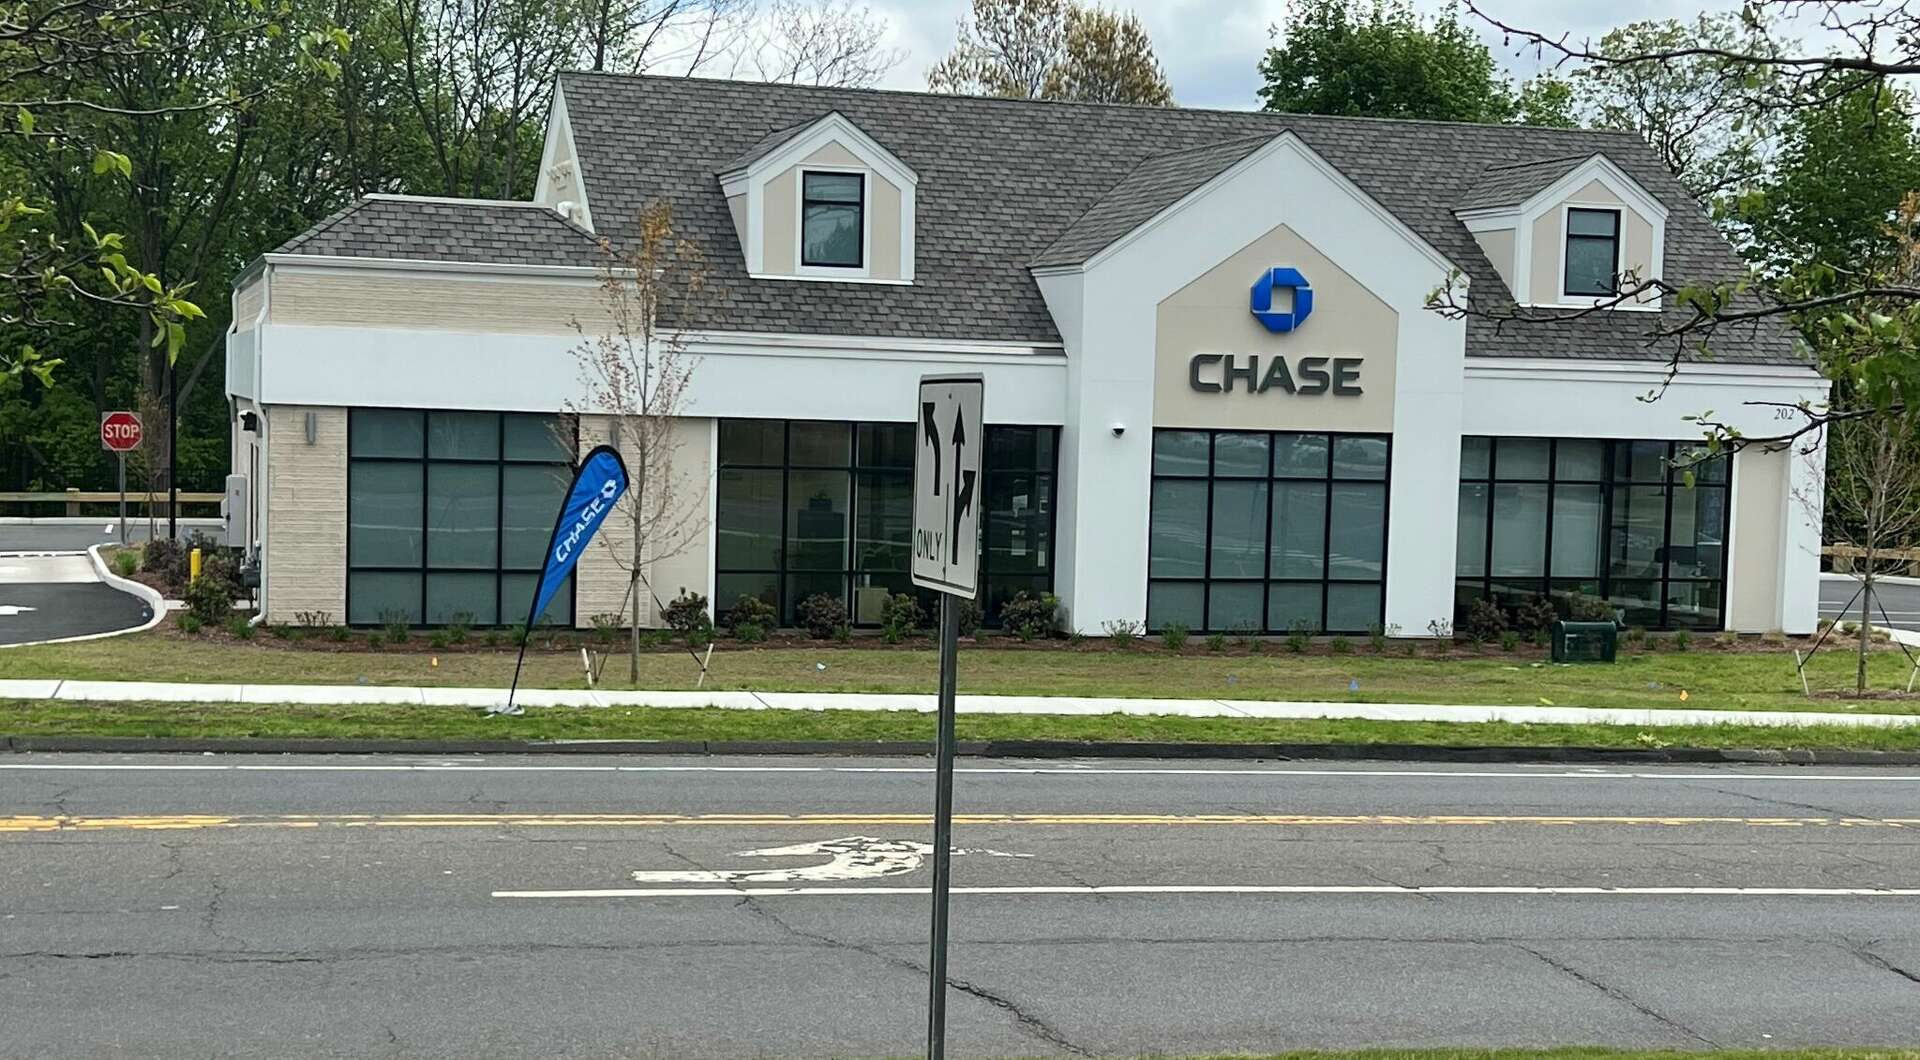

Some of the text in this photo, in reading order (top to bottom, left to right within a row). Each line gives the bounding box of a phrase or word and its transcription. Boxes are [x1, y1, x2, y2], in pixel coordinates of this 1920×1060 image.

[1189, 353, 1365, 396] CHASE
[104, 423, 140, 439] STOP
[1773, 407, 1795, 421] 202
[555, 496, 606, 563] CHASE
[916, 528, 943, 562] ONLY
